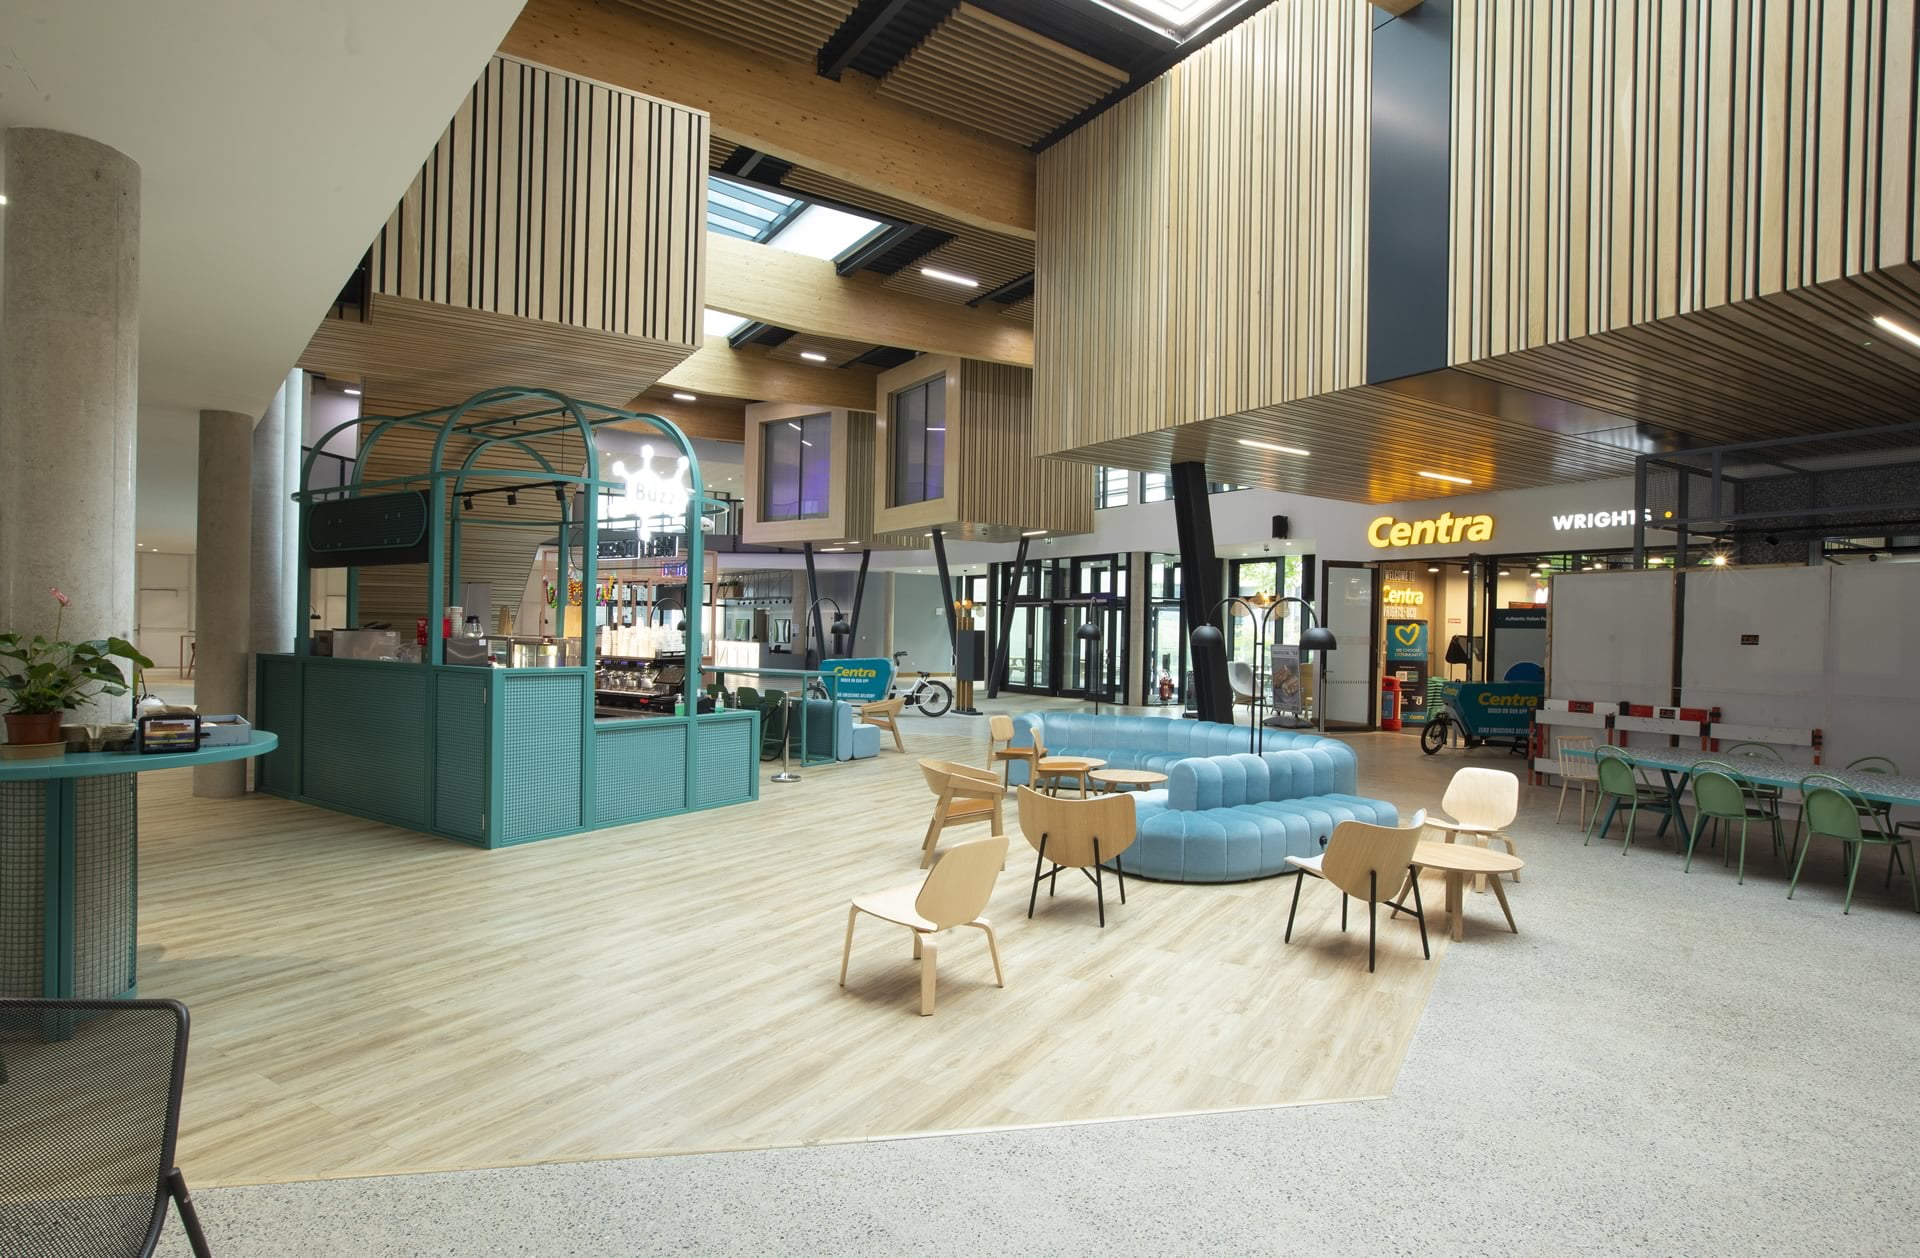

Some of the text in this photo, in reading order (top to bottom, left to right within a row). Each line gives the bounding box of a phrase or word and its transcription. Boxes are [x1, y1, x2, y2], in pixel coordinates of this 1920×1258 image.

[636, 482, 676, 505] Buzz
[1367, 511, 1493, 548] Centra
[1552, 508, 1653, 531] WRIGHTS
[1383, 585, 1424, 605] Centra
[833, 666, 877, 678] Centra
[1478, 691, 1538, 706] Centra
